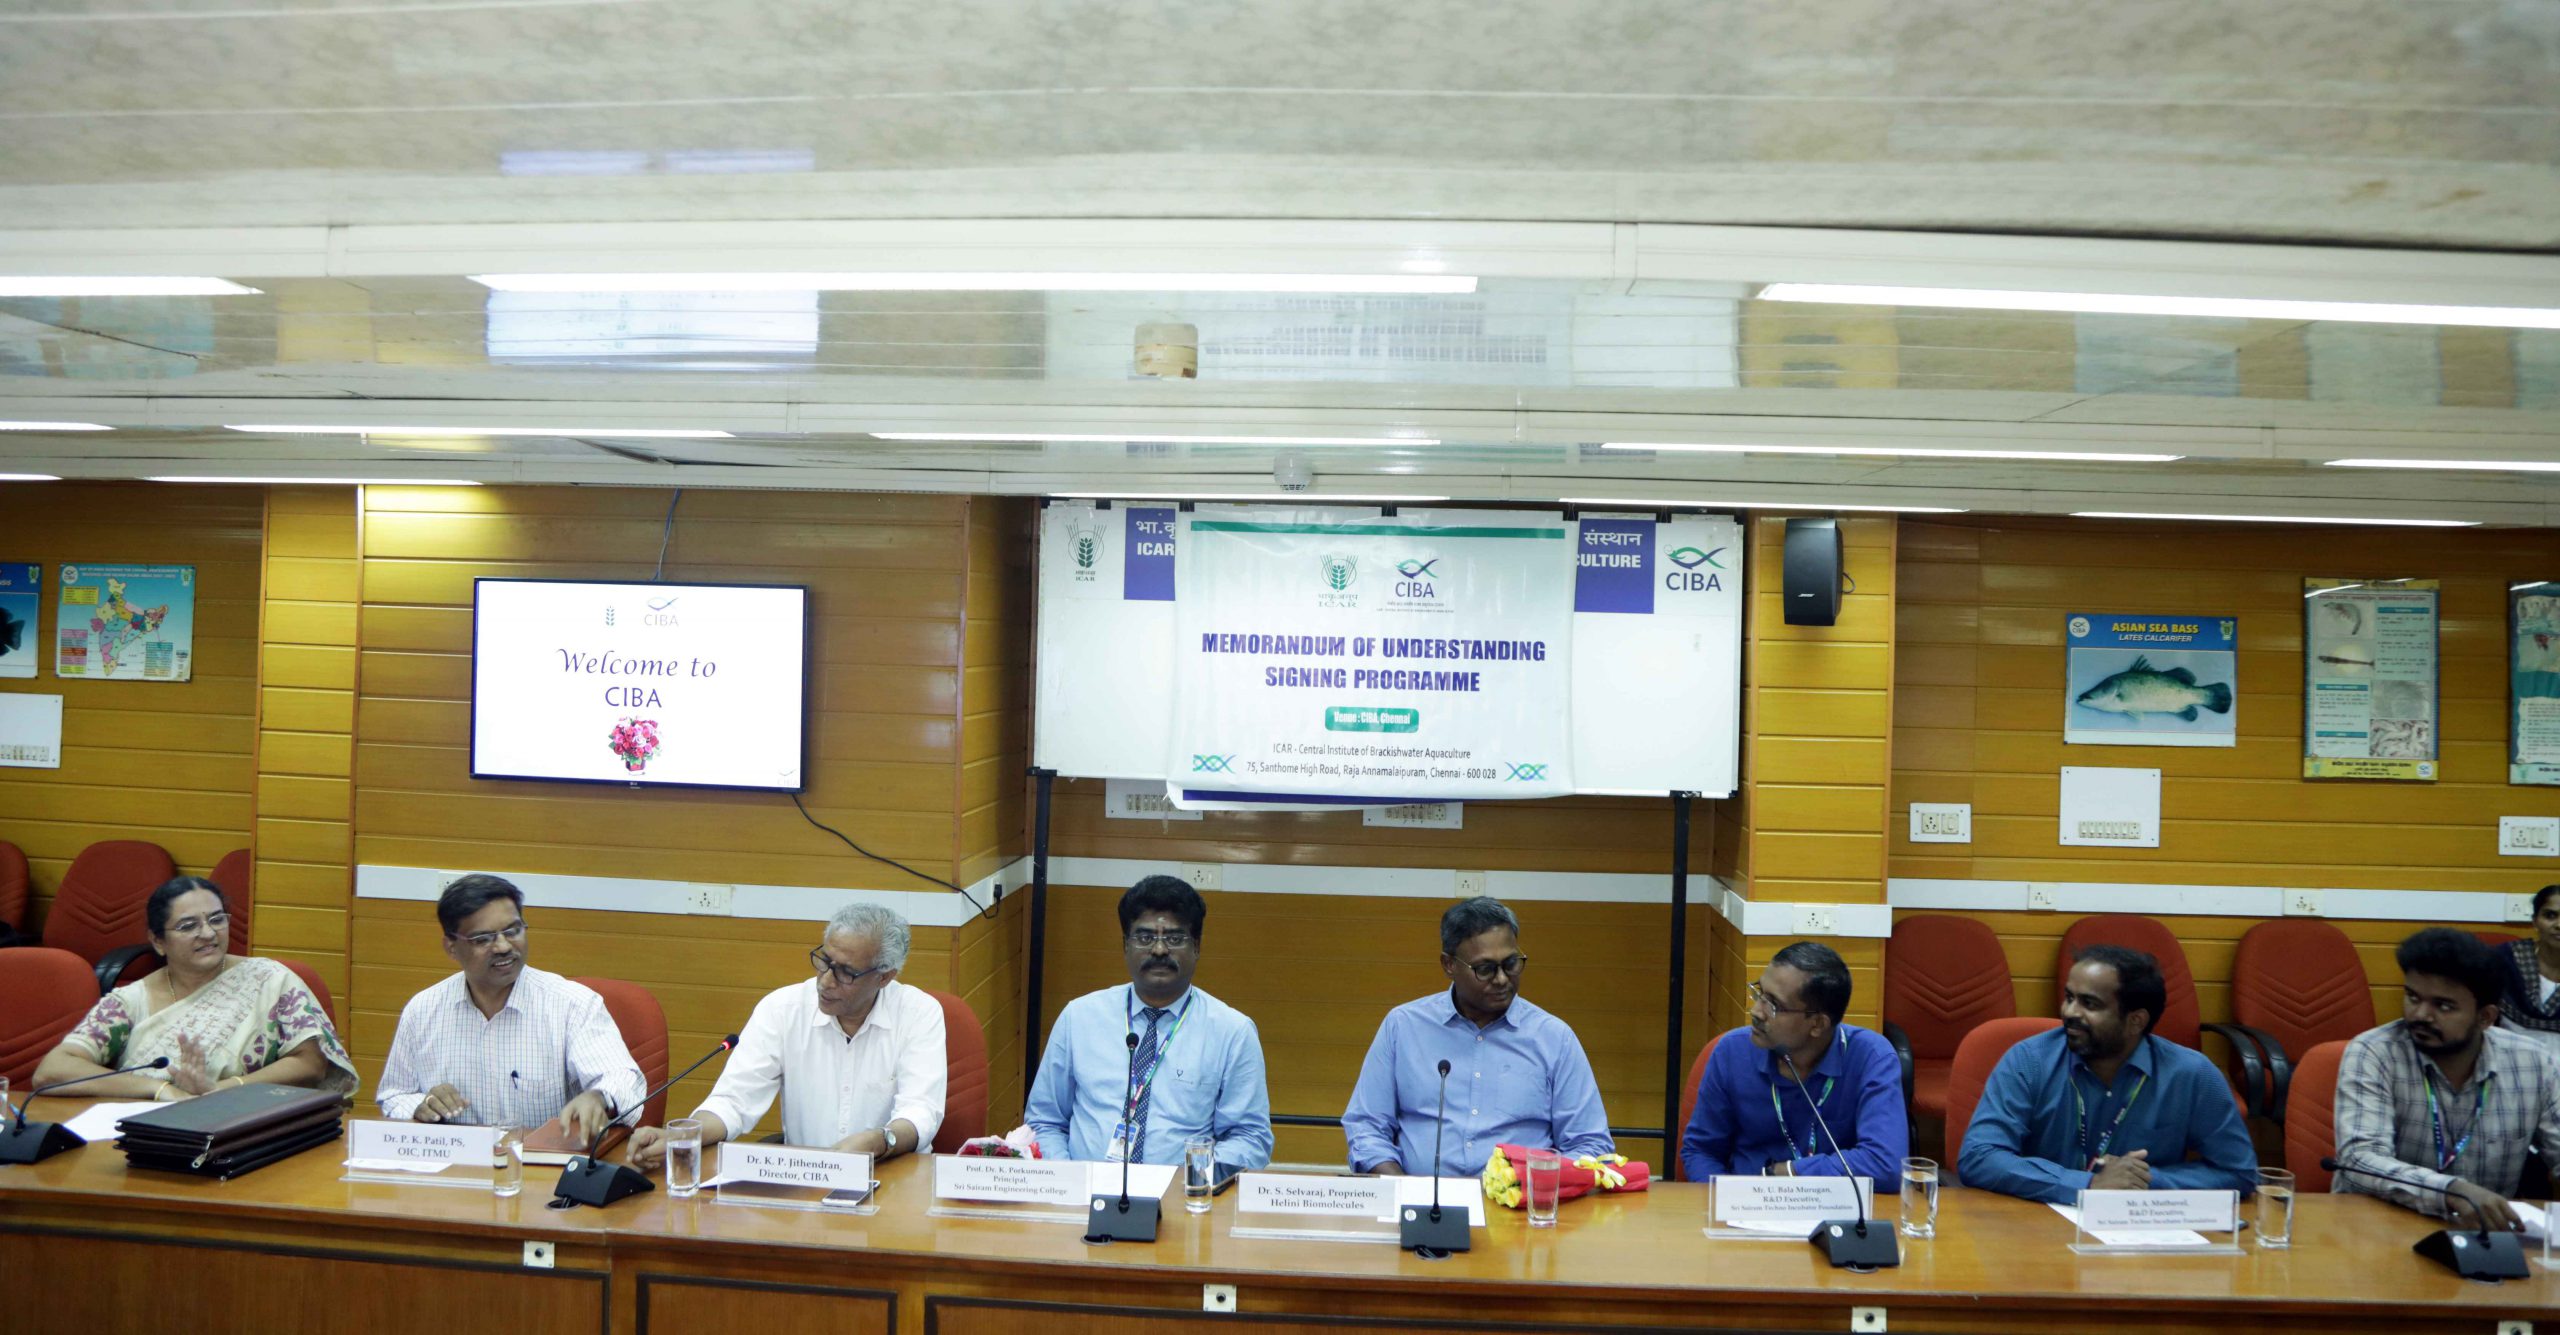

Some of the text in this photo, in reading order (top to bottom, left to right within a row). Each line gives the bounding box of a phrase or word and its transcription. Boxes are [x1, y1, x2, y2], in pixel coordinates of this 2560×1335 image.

[1584, 529, 1642, 546] संस्थान
[1137, 543, 1175, 556] ICAR
[1666, 572, 1721, 591] CIBA
[1395, 582, 1434, 598] CIBA
[644, 614, 679, 626] CIBA
[2112, 623, 2199, 633] ASIAN SEA BASS
[1202, 633, 1546, 661] MEMORANDUM OF UNDERSTANDING
[556, 649, 716, 677] Welcome to
[1265, 667, 1480, 692] SIGNING PROGRAMME
[605, 686, 662, 708] CIBA
[1334, 712, 1357, 723] Venue
[1361, 712, 1379, 724] CIBA,
[1381, 713, 1410, 724] Chennai
[1273, 743, 1292, 753] ICAR
[1299, 744, 1326, 755] Central
[1328, 745, 1359, 756] Institute
[1361, 745, 1369, 756] of
[1370, 746, 1423, 758] Brackishwater
[1425, 748, 1471, 760] Aquaculture
[1247, 762, 1258, 774] 75,
[1260, 762, 1298, 773] Santhome
[1300, 764, 1318, 776] High
[1320, 764, 1341, 776] Road,
[1343, 765, 1360, 778] Raja
[1362, 766, 1428, 779] Annamalaipuram,
[1431, 767, 1460, 778] Chennai
[1467, 768, 1480, 778] 600
[1483, 769, 1496, 779] 028
[383, 1134, 465, 1147] Dr. P. K. Patil, PS,
[398, 1148, 450, 1158] OIC, ITMU
[747, 1155, 842, 1171] Dr. K. P. Jithendran,
[759, 1169, 829, 1182] Director, CIBA
[993, 1176, 1027, 1184] Principal,
[994, 1186, 1038, 1195] Engineering
[1040, 1187, 1067, 1195] College
[1258, 1187, 1272, 1195] Dr.
[1287, 1188, 1325, 1198] Selvaraj,
[1328, 1189, 1378, 1199] Proprietor,
[1796, 1187, 1832, 1195] Murugan,
[1271, 1199, 1364, 1209] Helini Biomolecules
